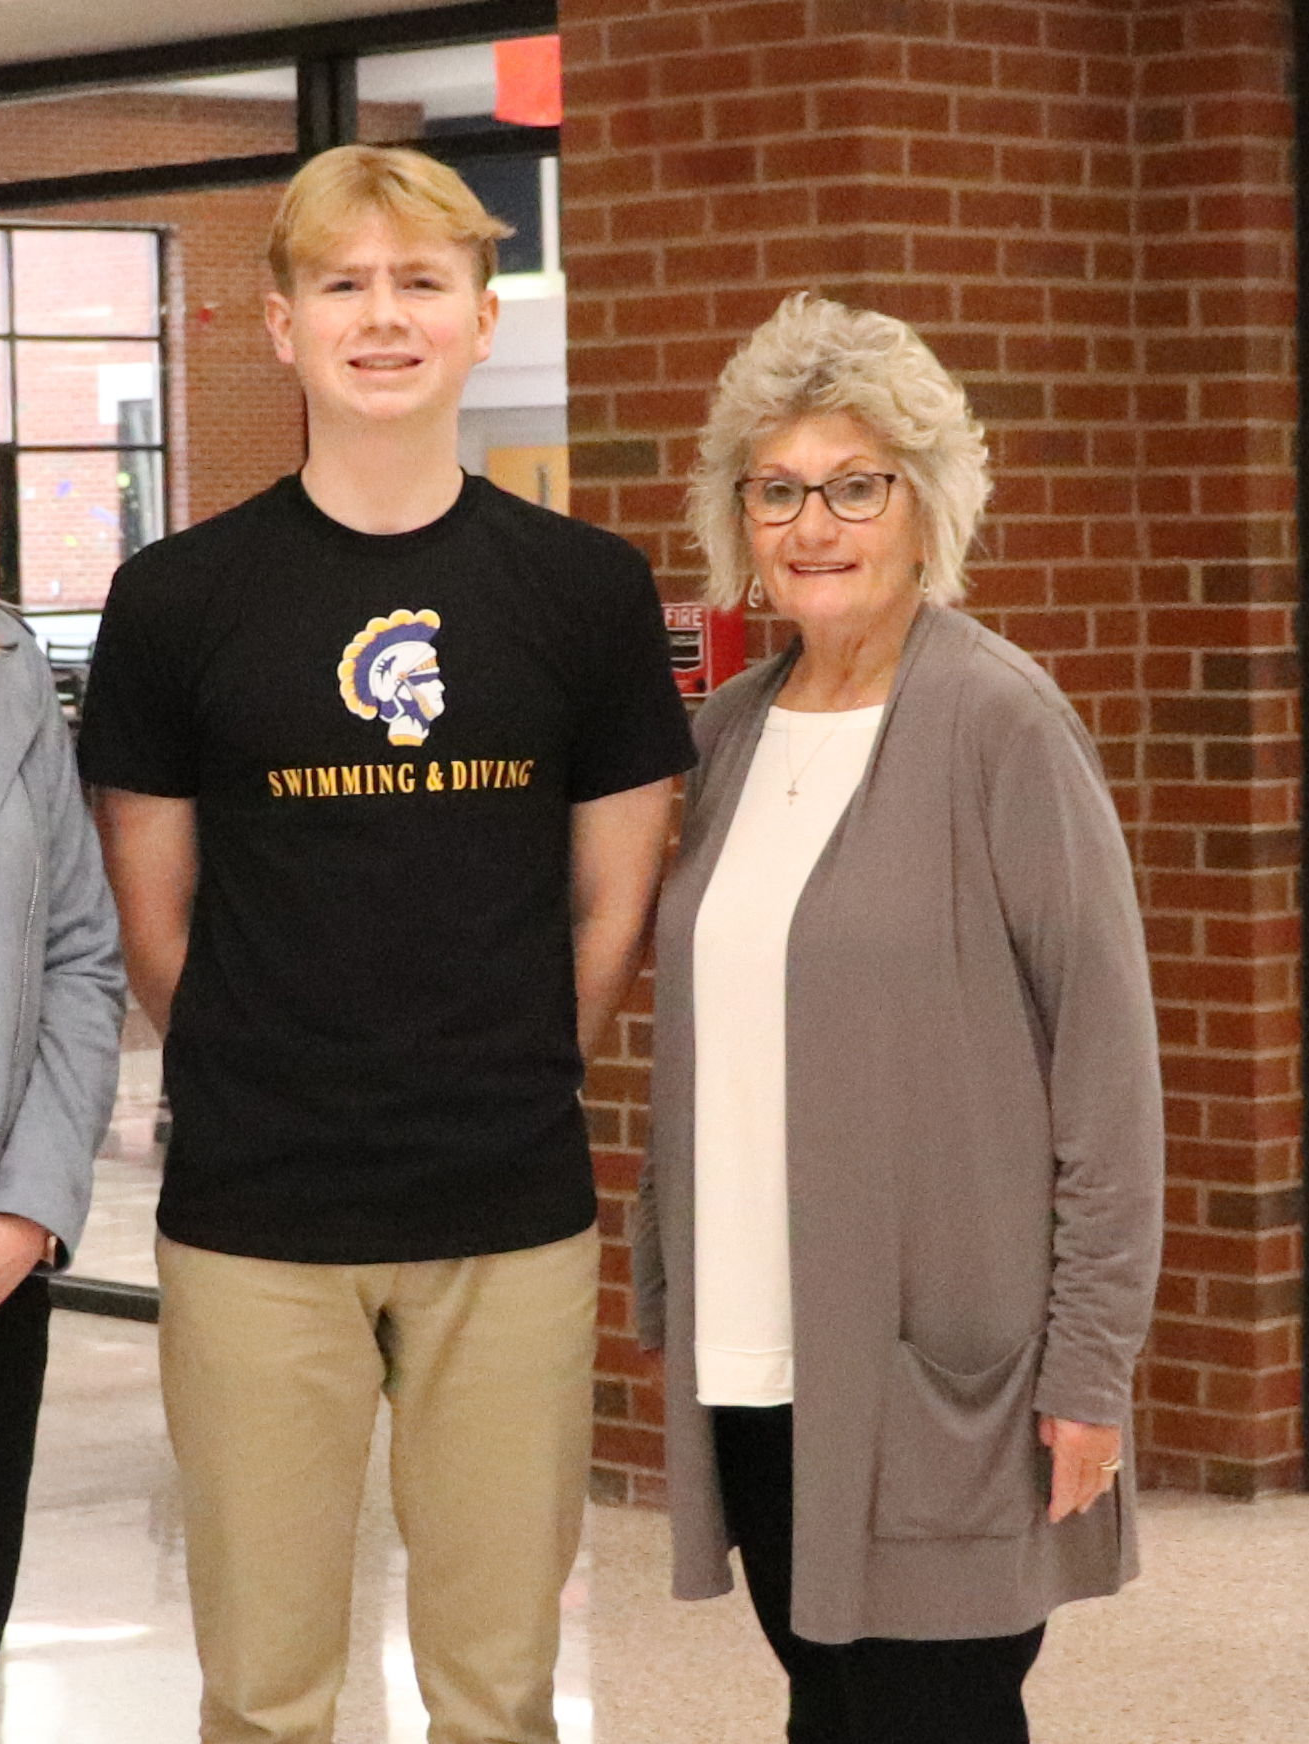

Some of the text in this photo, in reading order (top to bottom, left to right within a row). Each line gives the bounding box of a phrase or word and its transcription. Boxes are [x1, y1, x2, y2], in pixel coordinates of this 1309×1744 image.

[664, 607, 703, 627] FIRE
[268, 760, 534, 797] SWIMMING & DIVING
